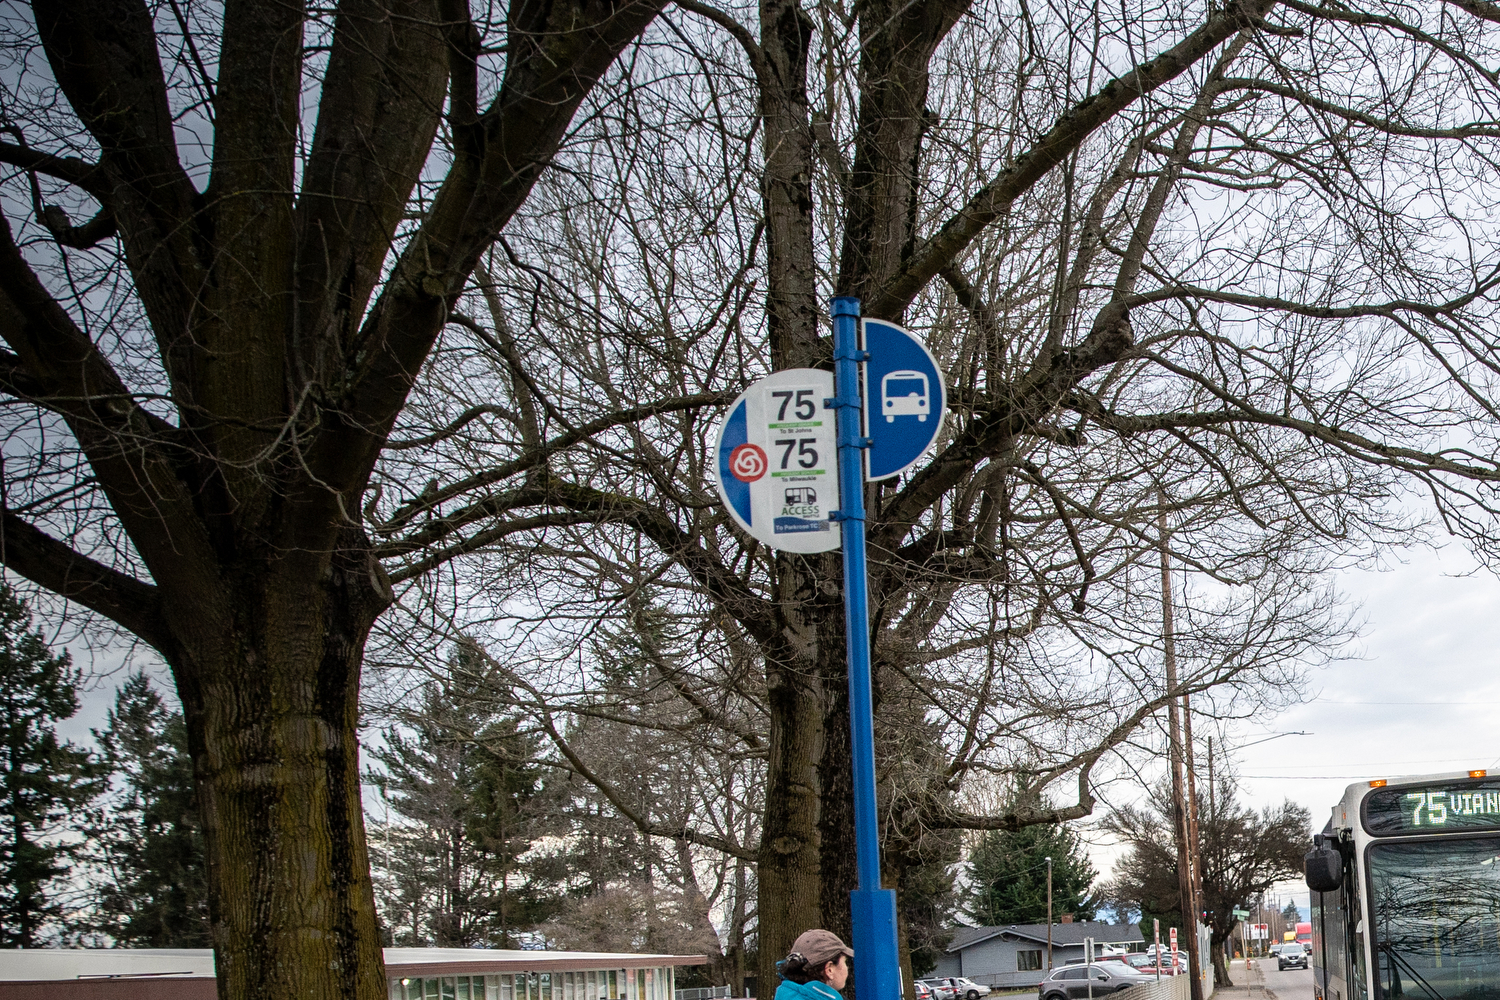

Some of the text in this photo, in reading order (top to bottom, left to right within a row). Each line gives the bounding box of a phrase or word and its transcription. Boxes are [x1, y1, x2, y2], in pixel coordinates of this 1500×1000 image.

[772, 390, 816, 421] 75
[775, 438, 819, 469] 75
[781, 506, 819, 516] ACCESS
[1407, 791, 1448, 825] 75
[1450, 793, 1484, 815] VIA
